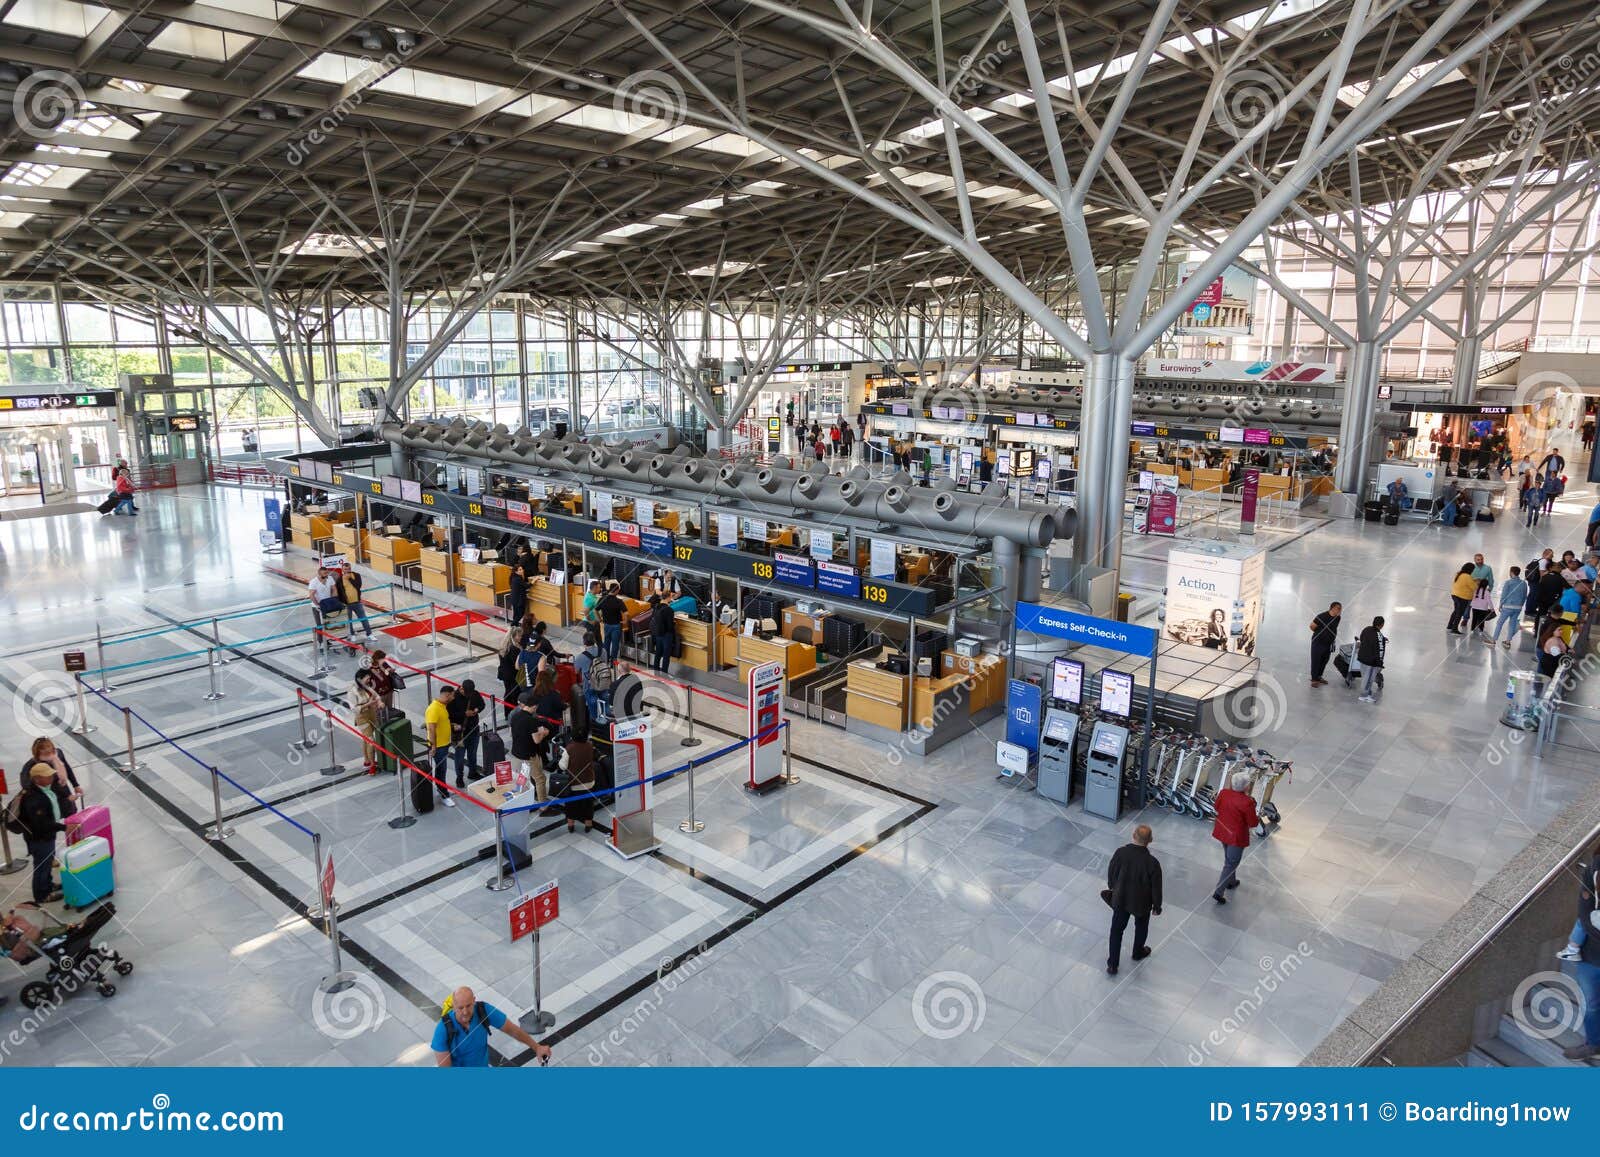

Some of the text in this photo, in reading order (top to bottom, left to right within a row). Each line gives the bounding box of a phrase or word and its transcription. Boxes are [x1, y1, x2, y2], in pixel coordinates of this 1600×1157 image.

[1160, 363, 1201, 374] Eurowings
[1055, 420, 1066, 428] 154
[1156, 428, 1168, 436] 156
[1271, 436, 1285, 446] 158
[333, 473, 342, 485] 131
[370, 483, 381, 494] 132
[422, 493, 434, 505] 133
[469, 503, 482, 515] 134
[532, 515, 547, 529] 135
[592, 528, 608, 543] 136
[674, 545, 693, 560] 137
[752, 562, 773, 579] 138
[1177, 576, 1216, 592] Action
[863, 585, 887, 603] 139
[1039, 615, 1127, 642] Express Self-Check-in
